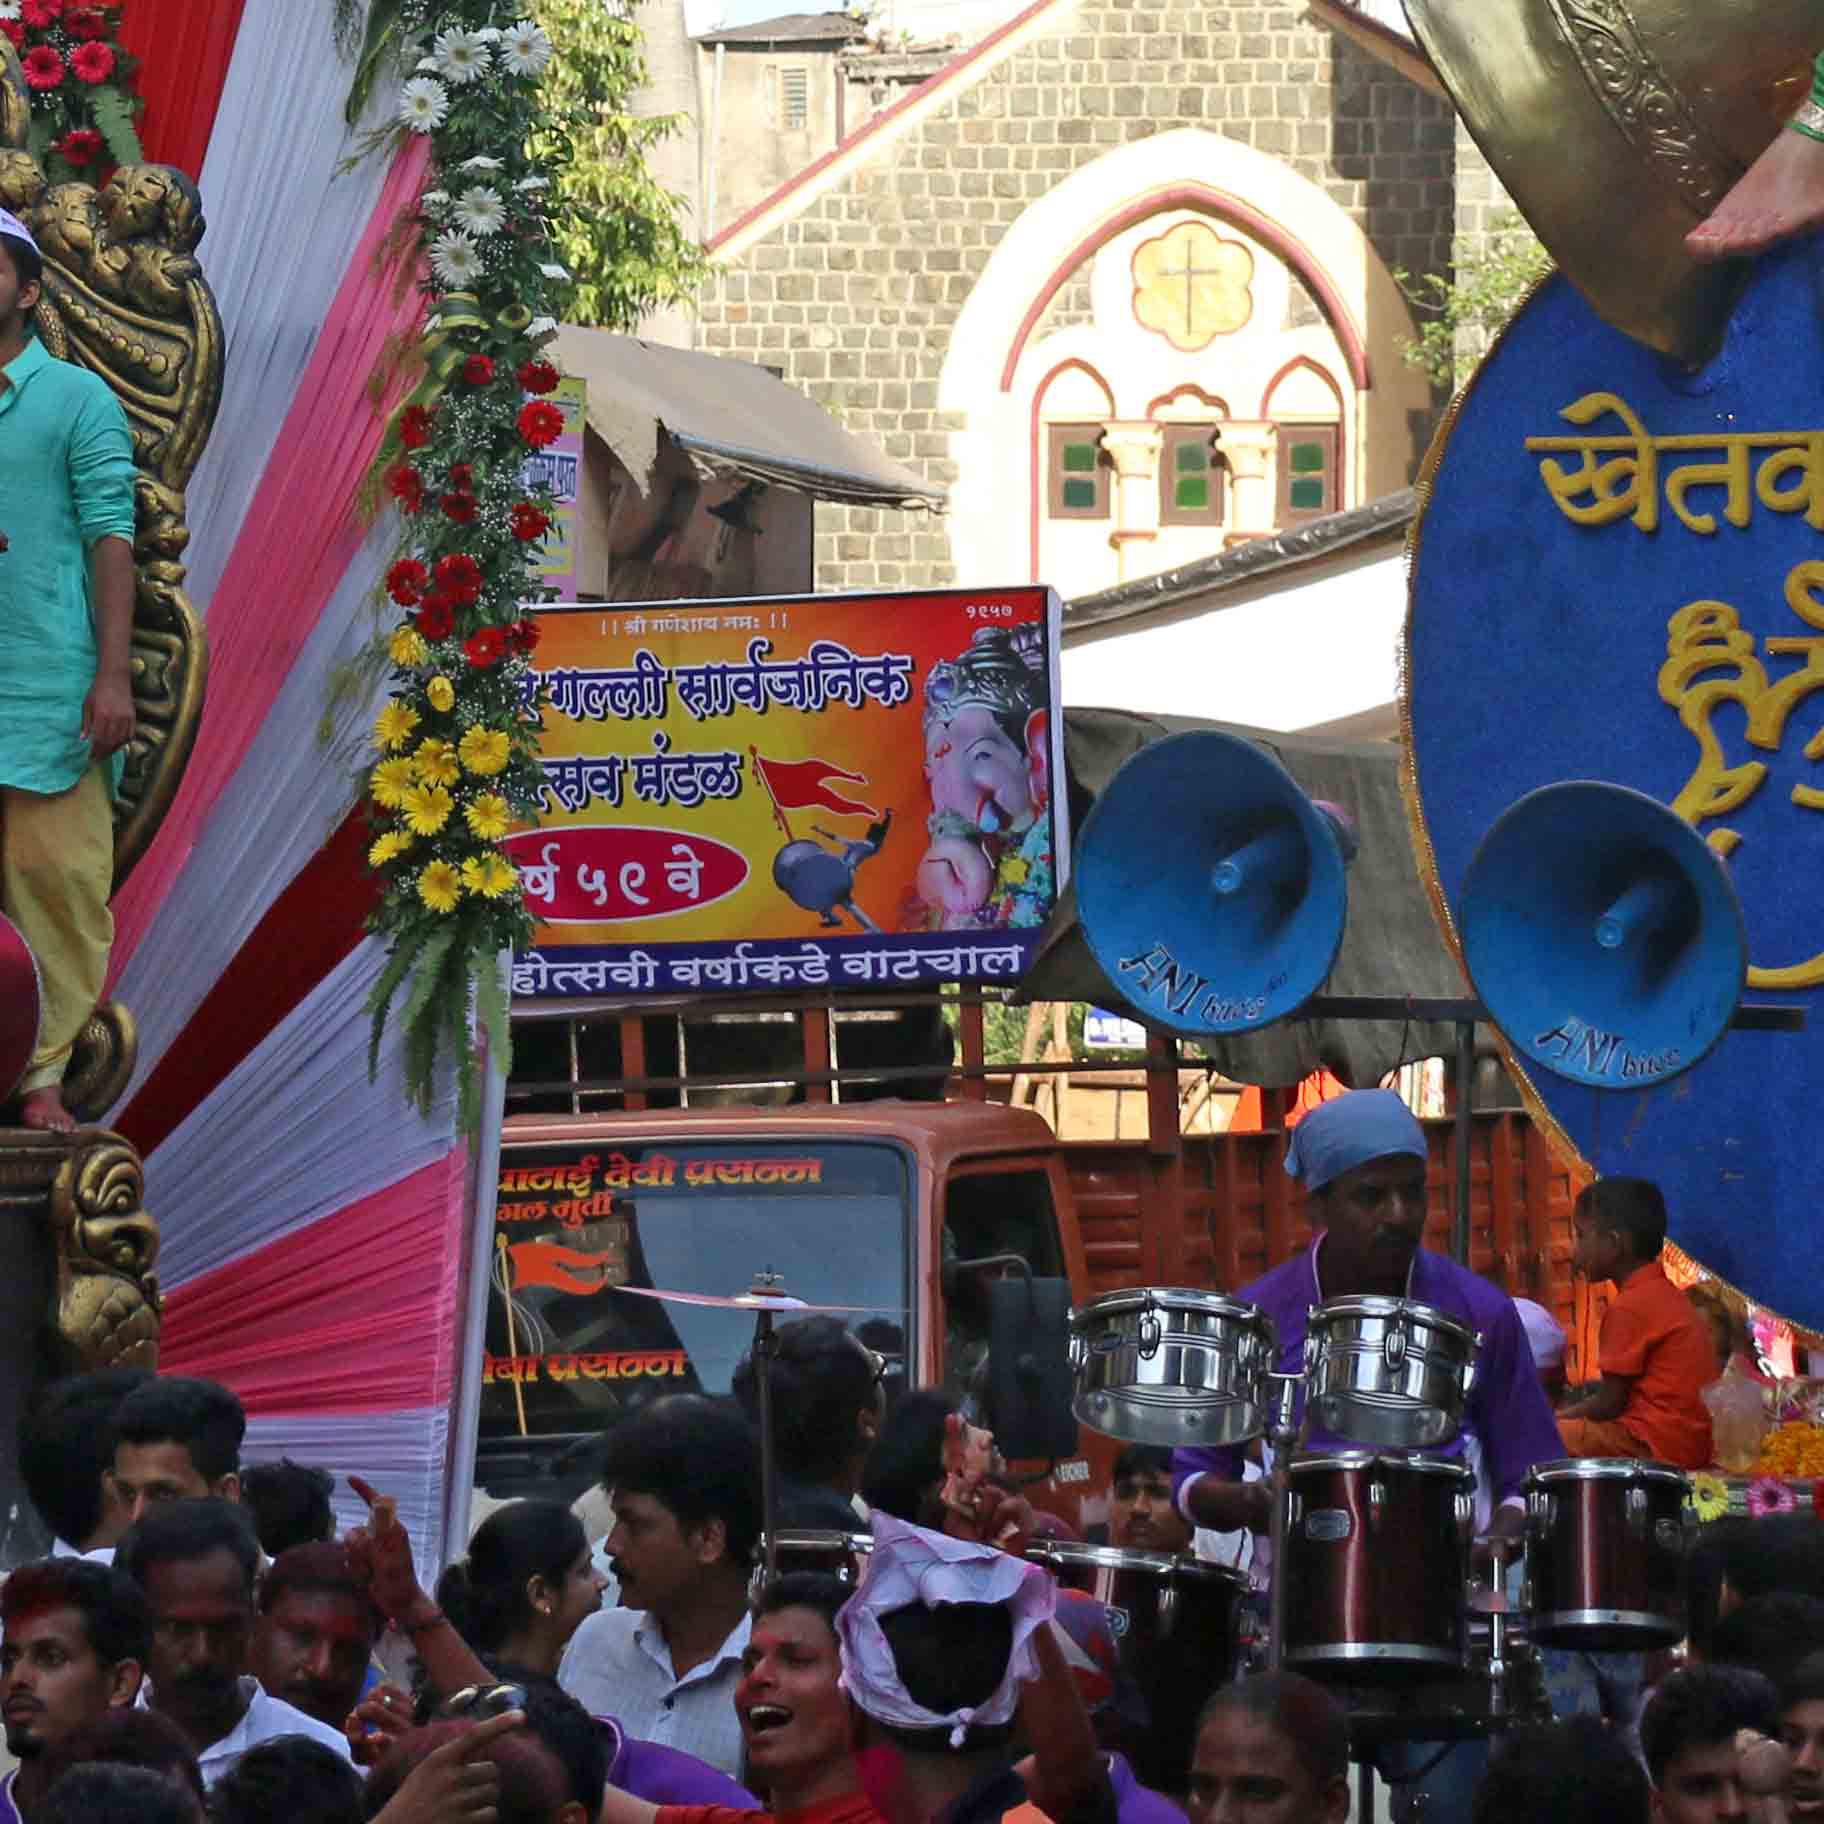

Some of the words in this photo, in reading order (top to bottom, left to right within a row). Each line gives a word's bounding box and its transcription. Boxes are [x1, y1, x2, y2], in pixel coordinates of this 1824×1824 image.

[623, 614, 647, 635] श्री
[651, 612, 718, 634] गणेशाय
[545, 648, 670, 721] गल्ली
[673, 635, 915, 722] सार्वजनिक
[628, 729, 743, 808] मंडळ
[663, 843, 706, 900] वे
[511, 949, 661, 996] होत्सवी
[668, 941, 830, 987] वर्षाकडे
[839, 944, 1026, 981] वाटचाल
[604, 1151, 676, 1188] देवी
[683, 1154, 824, 1188] प्रसन्न
[547, 1348, 687, 1384] प्रसन्न
